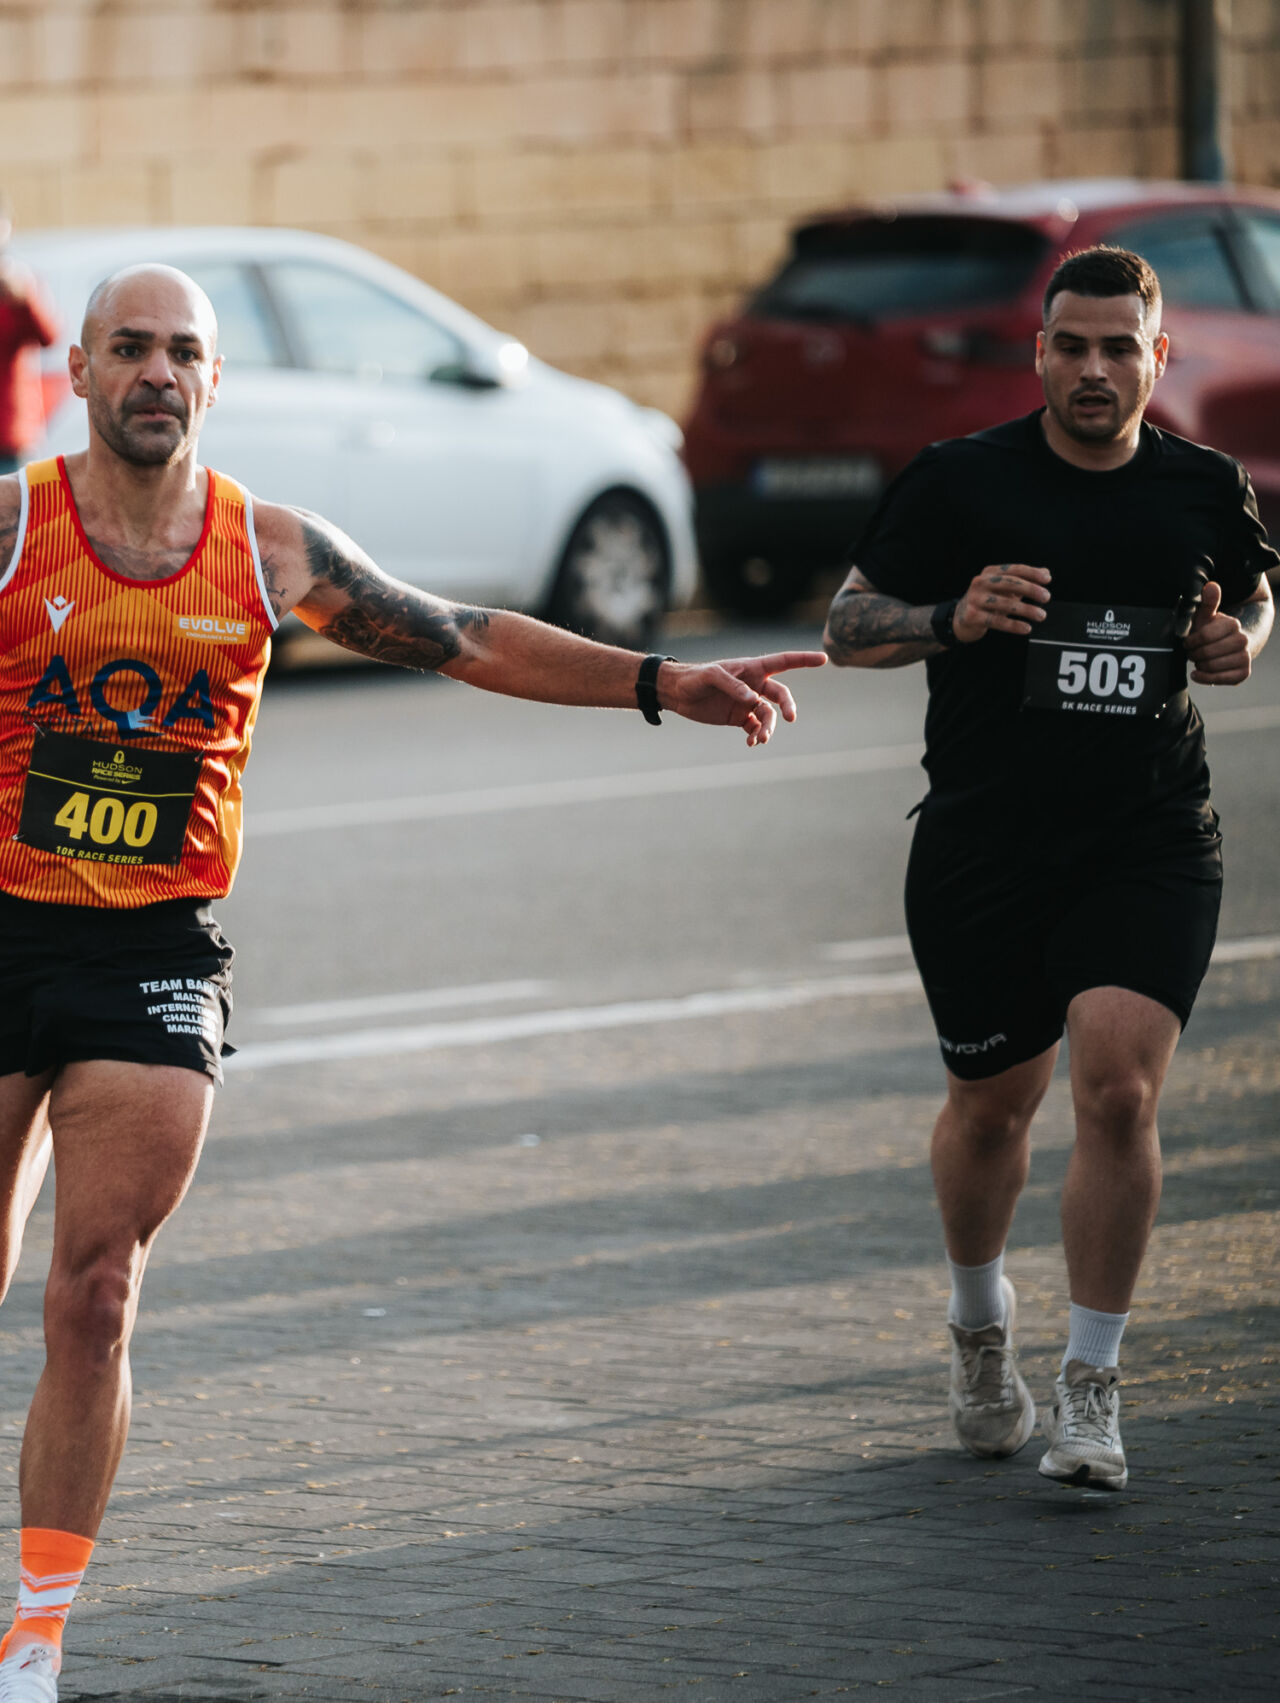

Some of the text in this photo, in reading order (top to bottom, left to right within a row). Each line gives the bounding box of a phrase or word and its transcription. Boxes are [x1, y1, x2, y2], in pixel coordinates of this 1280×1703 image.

[179, 618, 246, 635] EVOLVE
[1086, 621, 1131, 630] HUDSON
[1057, 650, 1146, 699] 503
[26, 655, 215, 740] AQA
[1076, 702, 1102, 713] RACE
[1104, 704, 1137, 715] SERIES
[92, 760, 143, 775] HUDSON
[54, 791, 158, 848] 400
[56, 845, 144, 865] 10K RACE SERIES
[140, 979, 183, 994] TEAM
[173, 992, 206, 1005] MALTA
